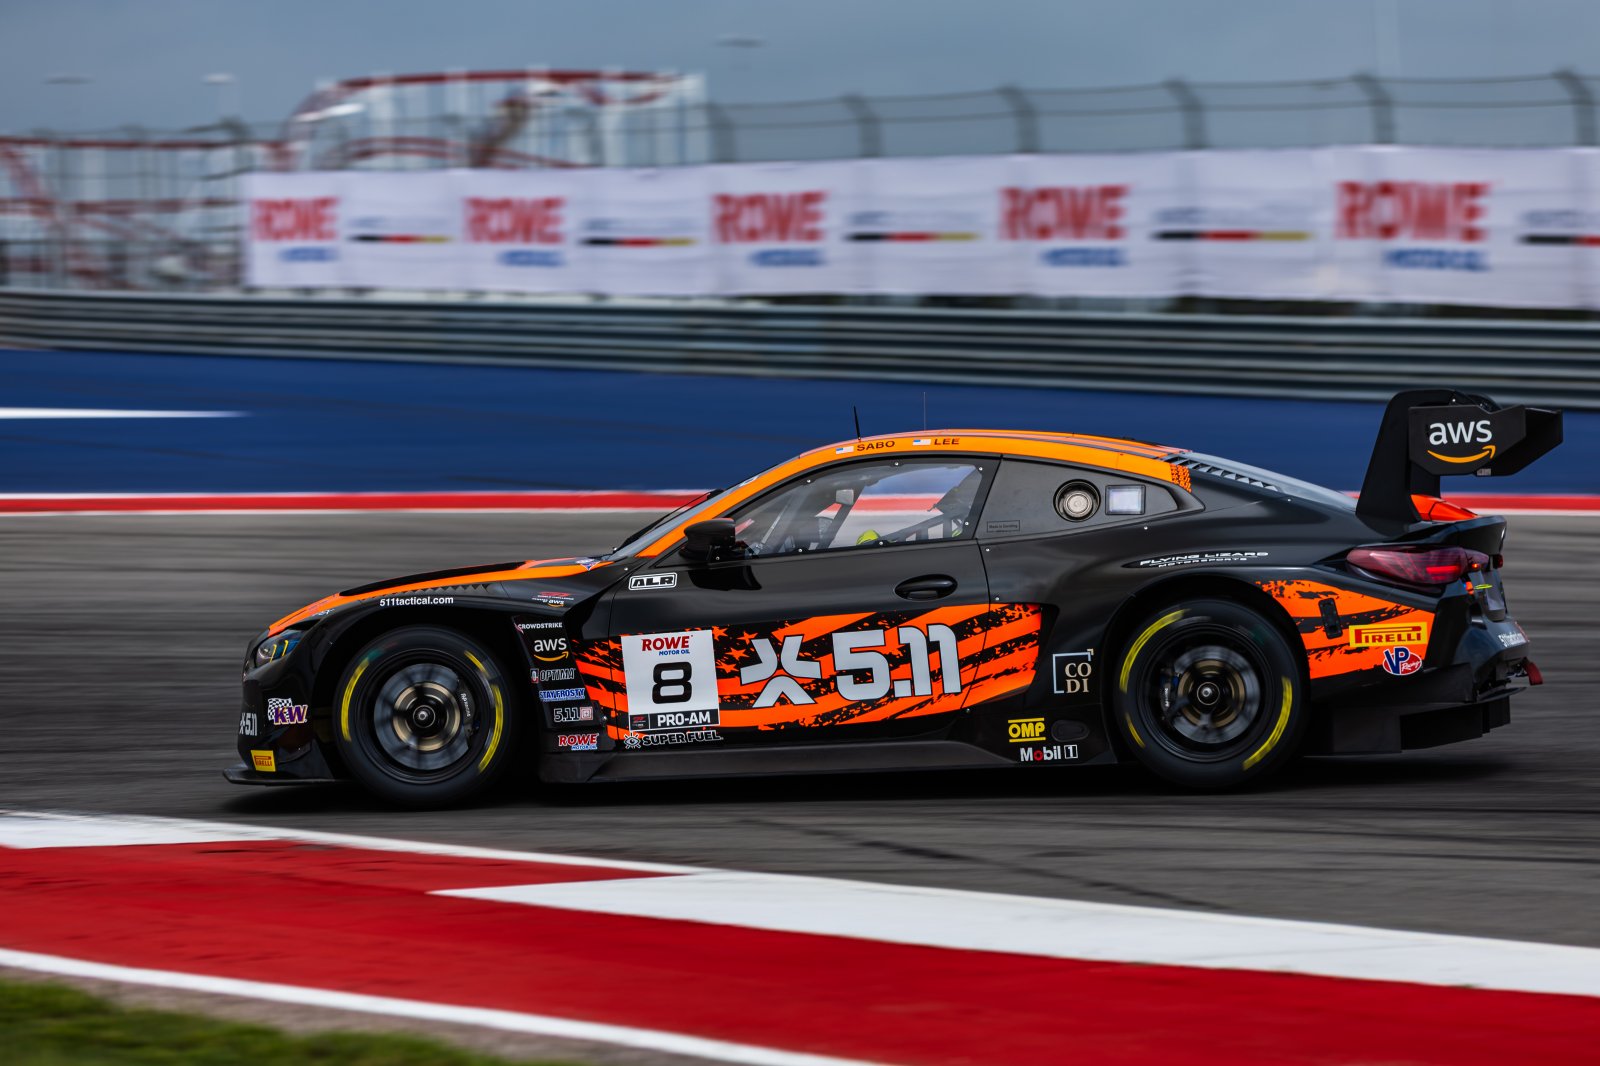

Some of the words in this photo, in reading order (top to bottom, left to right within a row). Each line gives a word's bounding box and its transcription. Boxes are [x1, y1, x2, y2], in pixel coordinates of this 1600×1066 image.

[1429, 420, 1493, 446] aws
[857, 440, 895, 452] SABO
[934, 437, 960, 446] LEE
[1140, 554, 1199, 566] FLYING
[632, 575, 675, 588] ALR
[379, 596, 454, 607] 511tactical.com
[517, 621, 563, 630] CROWDSTRIKE
[1354, 625, 1422, 644] PIRELLI
[534, 637, 567, 652] aws
[641, 636, 690, 652] ROWE
[832, 623, 962, 701] 5.11
[1383, 646, 1410, 675] VP
[540, 668, 576, 682] OPTIMA
[1064, 662, 1092, 679] CO
[652, 661, 693, 704] 8
[1066, 678, 1090, 694] DI
[539, 689, 555, 699] STAY
[556, 687, 585, 699] FROSTY
[273, 704, 308, 726] KW
[554, 707, 580, 723] 5.11
[657, 711, 711, 727] PRO-AM
[642, 732, 686, 746] SUPER
[686, 730, 721, 743] FUEL
[1008, 721, 1046, 739] OMP
[558, 733, 599, 747] ROWE
[1020, 745, 1062, 762] Mobil
